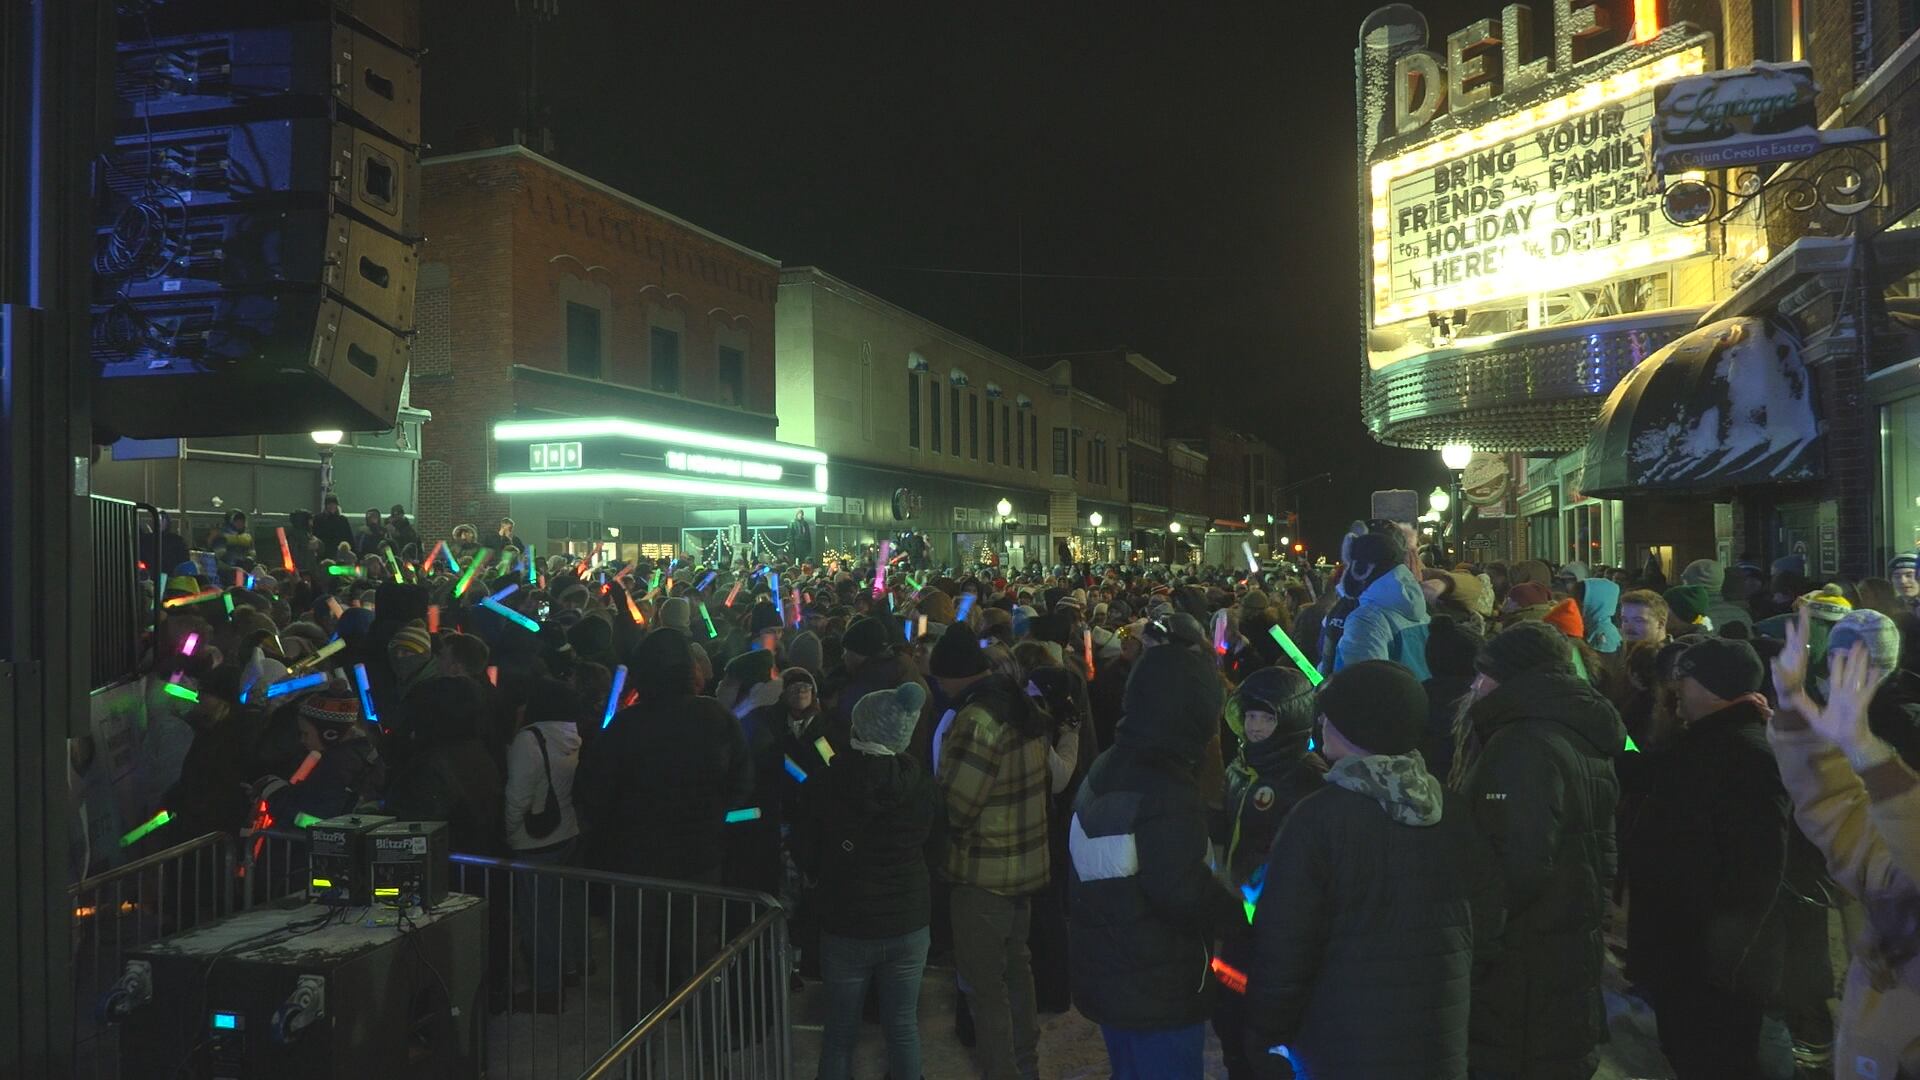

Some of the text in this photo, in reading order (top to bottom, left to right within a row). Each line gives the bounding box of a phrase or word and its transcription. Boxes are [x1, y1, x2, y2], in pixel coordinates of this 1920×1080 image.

[1398, 134, 1647, 238] FRIENDS AND FAMIL
[1434, 103, 1626, 196] BRING YOUR
[1670, 141, 1815, 166] A Cajun Creole Eatery
[1399, 242, 1420, 260] FOR
[1426, 200, 1537, 259] HOLIDAY
[1409, 269, 1422, 290] IN
[1522, 240, 1547, 259] THE
[1551, 200, 1658, 257] DELFT
